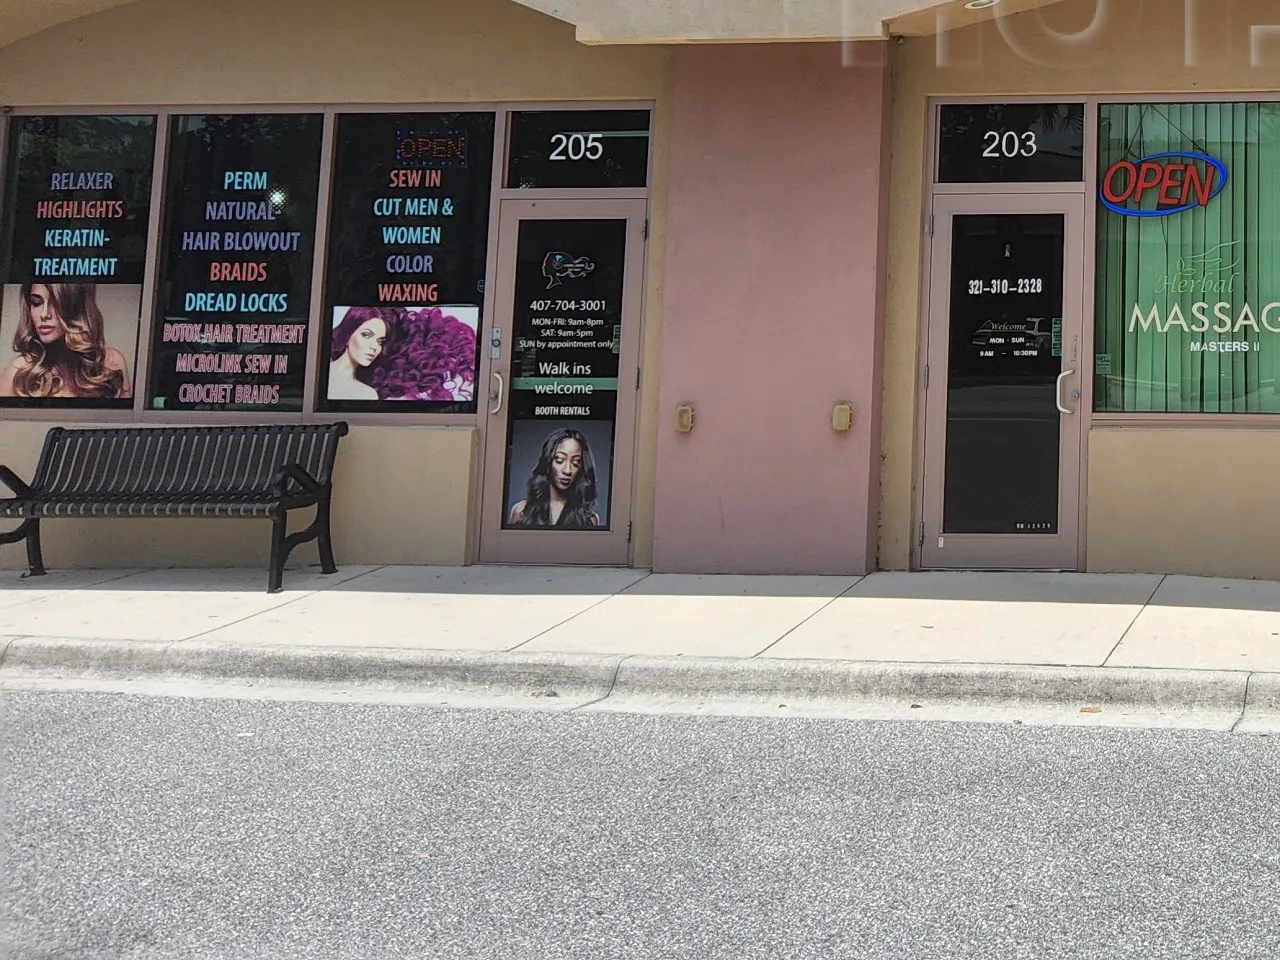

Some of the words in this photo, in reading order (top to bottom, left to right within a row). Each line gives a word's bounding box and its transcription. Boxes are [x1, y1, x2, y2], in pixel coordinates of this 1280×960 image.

[400, 138, 462, 157] OPEN
[548, 133, 604, 161] 205
[982, 130, 1037, 158] 203
[50, 171, 114, 190] RELAXER
[223, 171, 268, 190] PERM
[388, 169, 422, 188] SEW
[424, 169, 442, 188] IN
[1102, 160, 1216, 207] OPEN
[35, 200, 123, 219] HIGHLIGHTS
[373, 197, 403, 216] CUT
[404, 197, 439, 216] MEN
[441, 197, 454, 216] &
[44, 228, 111, 248] KERATIN-
[181, 231, 220, 251] HAIR
[223, 231, 301, 252] BLOWOUT
[381, 226, 441, 245] WOMEN
[33, 257, 118, 276] TREATMENT
[209, 262, 268, 282] BRAIDS
[385, 254, 434, 273] COLOR
[968, 278, 1043, 295] 321-310-2328
[1154, 271, 1240, 294] Herbal
[377, 283, 439, 302] WAXING
[184, 292, 237, 312] DREAD
[239, 293, 288, 313] LOCKS
[529, 300, 606, 312] 407-704-3001
[531, 317, 567, 327] MON-FRI:
[567, 318, 604, 328] 9am-8pm
[990, 320, 1027, 331] Welcome
[162, 323, 202, 343] BOTOX
[203, 323, 234, 344] HAIR
[235, 324, 306, 344] TREATMENT
[540, 328, 557, 338] SAT:
[557, 328, 594, 339] 9am-5pm
[519, 339, 536, 349] SUN
[536, 339, 546, 350] by
[547, 340, 596, 350] appointment
[597, 339, 615, 350] only
[1189, 341, 1250, 353] MASTERS
[175, 353, 243, 373] MICROLINK
[244, 354, 272, 374] SEW
[273, 354, 289, 374] IN
[538, 362, 570, 375] Walk
[572, 362, 591, 375] ins
[178, 383, 234, 404] CROCHET
[234, 384, 280, 405] BRAIDS
[534, 381, 594, 395] welcome
[534, 406, 559, 416] BOOTH
[560, 406, 591, 416] RENTALS
